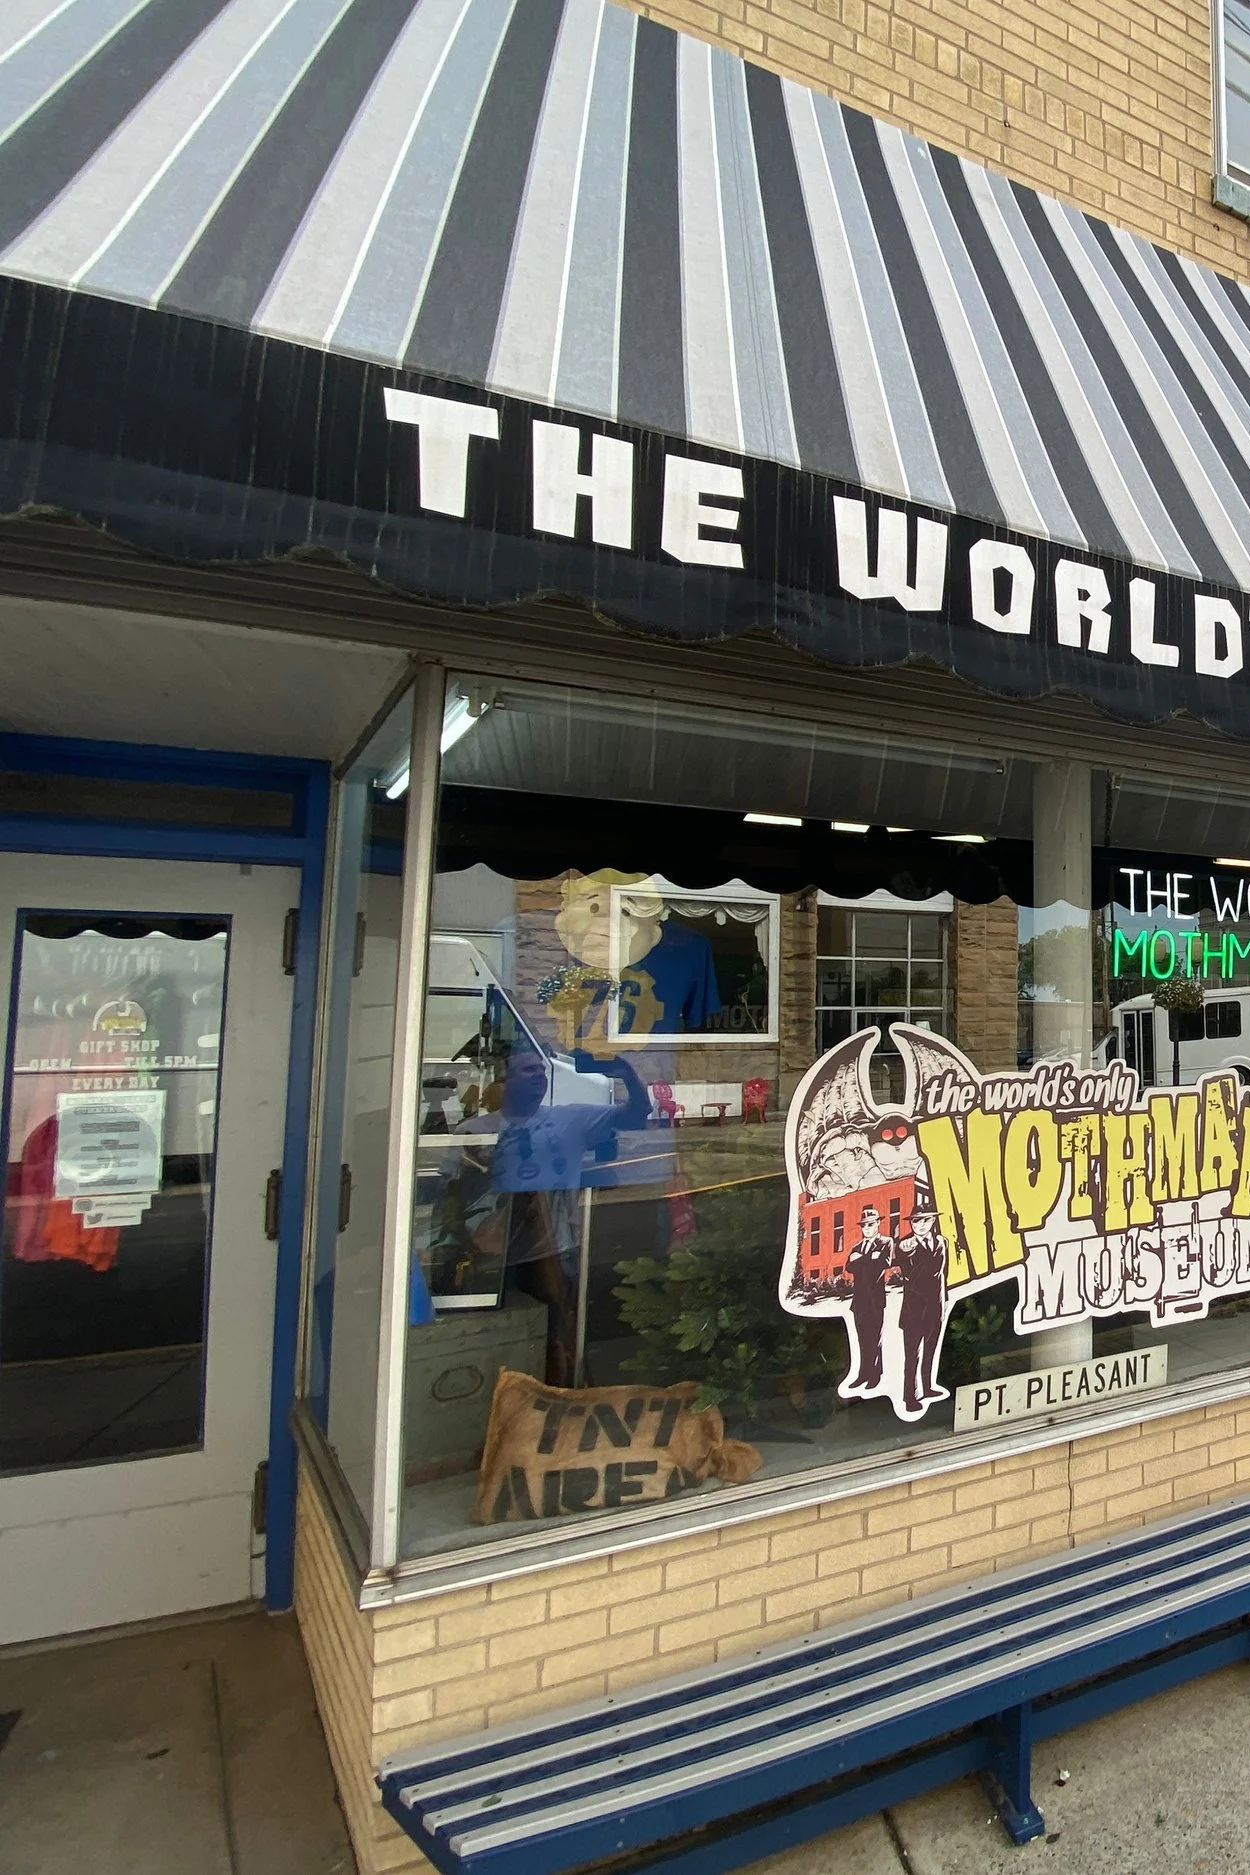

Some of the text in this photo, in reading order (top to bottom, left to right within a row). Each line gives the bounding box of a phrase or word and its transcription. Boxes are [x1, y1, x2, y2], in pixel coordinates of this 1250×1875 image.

[383, 386, 745, 570] THE
[1119, 868, 1194, 919] THE
[29, 1055, 198, 1070] OPEN TILL 5PM
[79, 1039, 160, 1053] GIFT SHOP
[72, 1076, 160, 1090] EVERY DAY
[925, 1066, 1133, 1112] the world's only
[974, 1353, 1151, 1421] PT. PLEASANT
[532, 1396, 699, 1454] TNT
